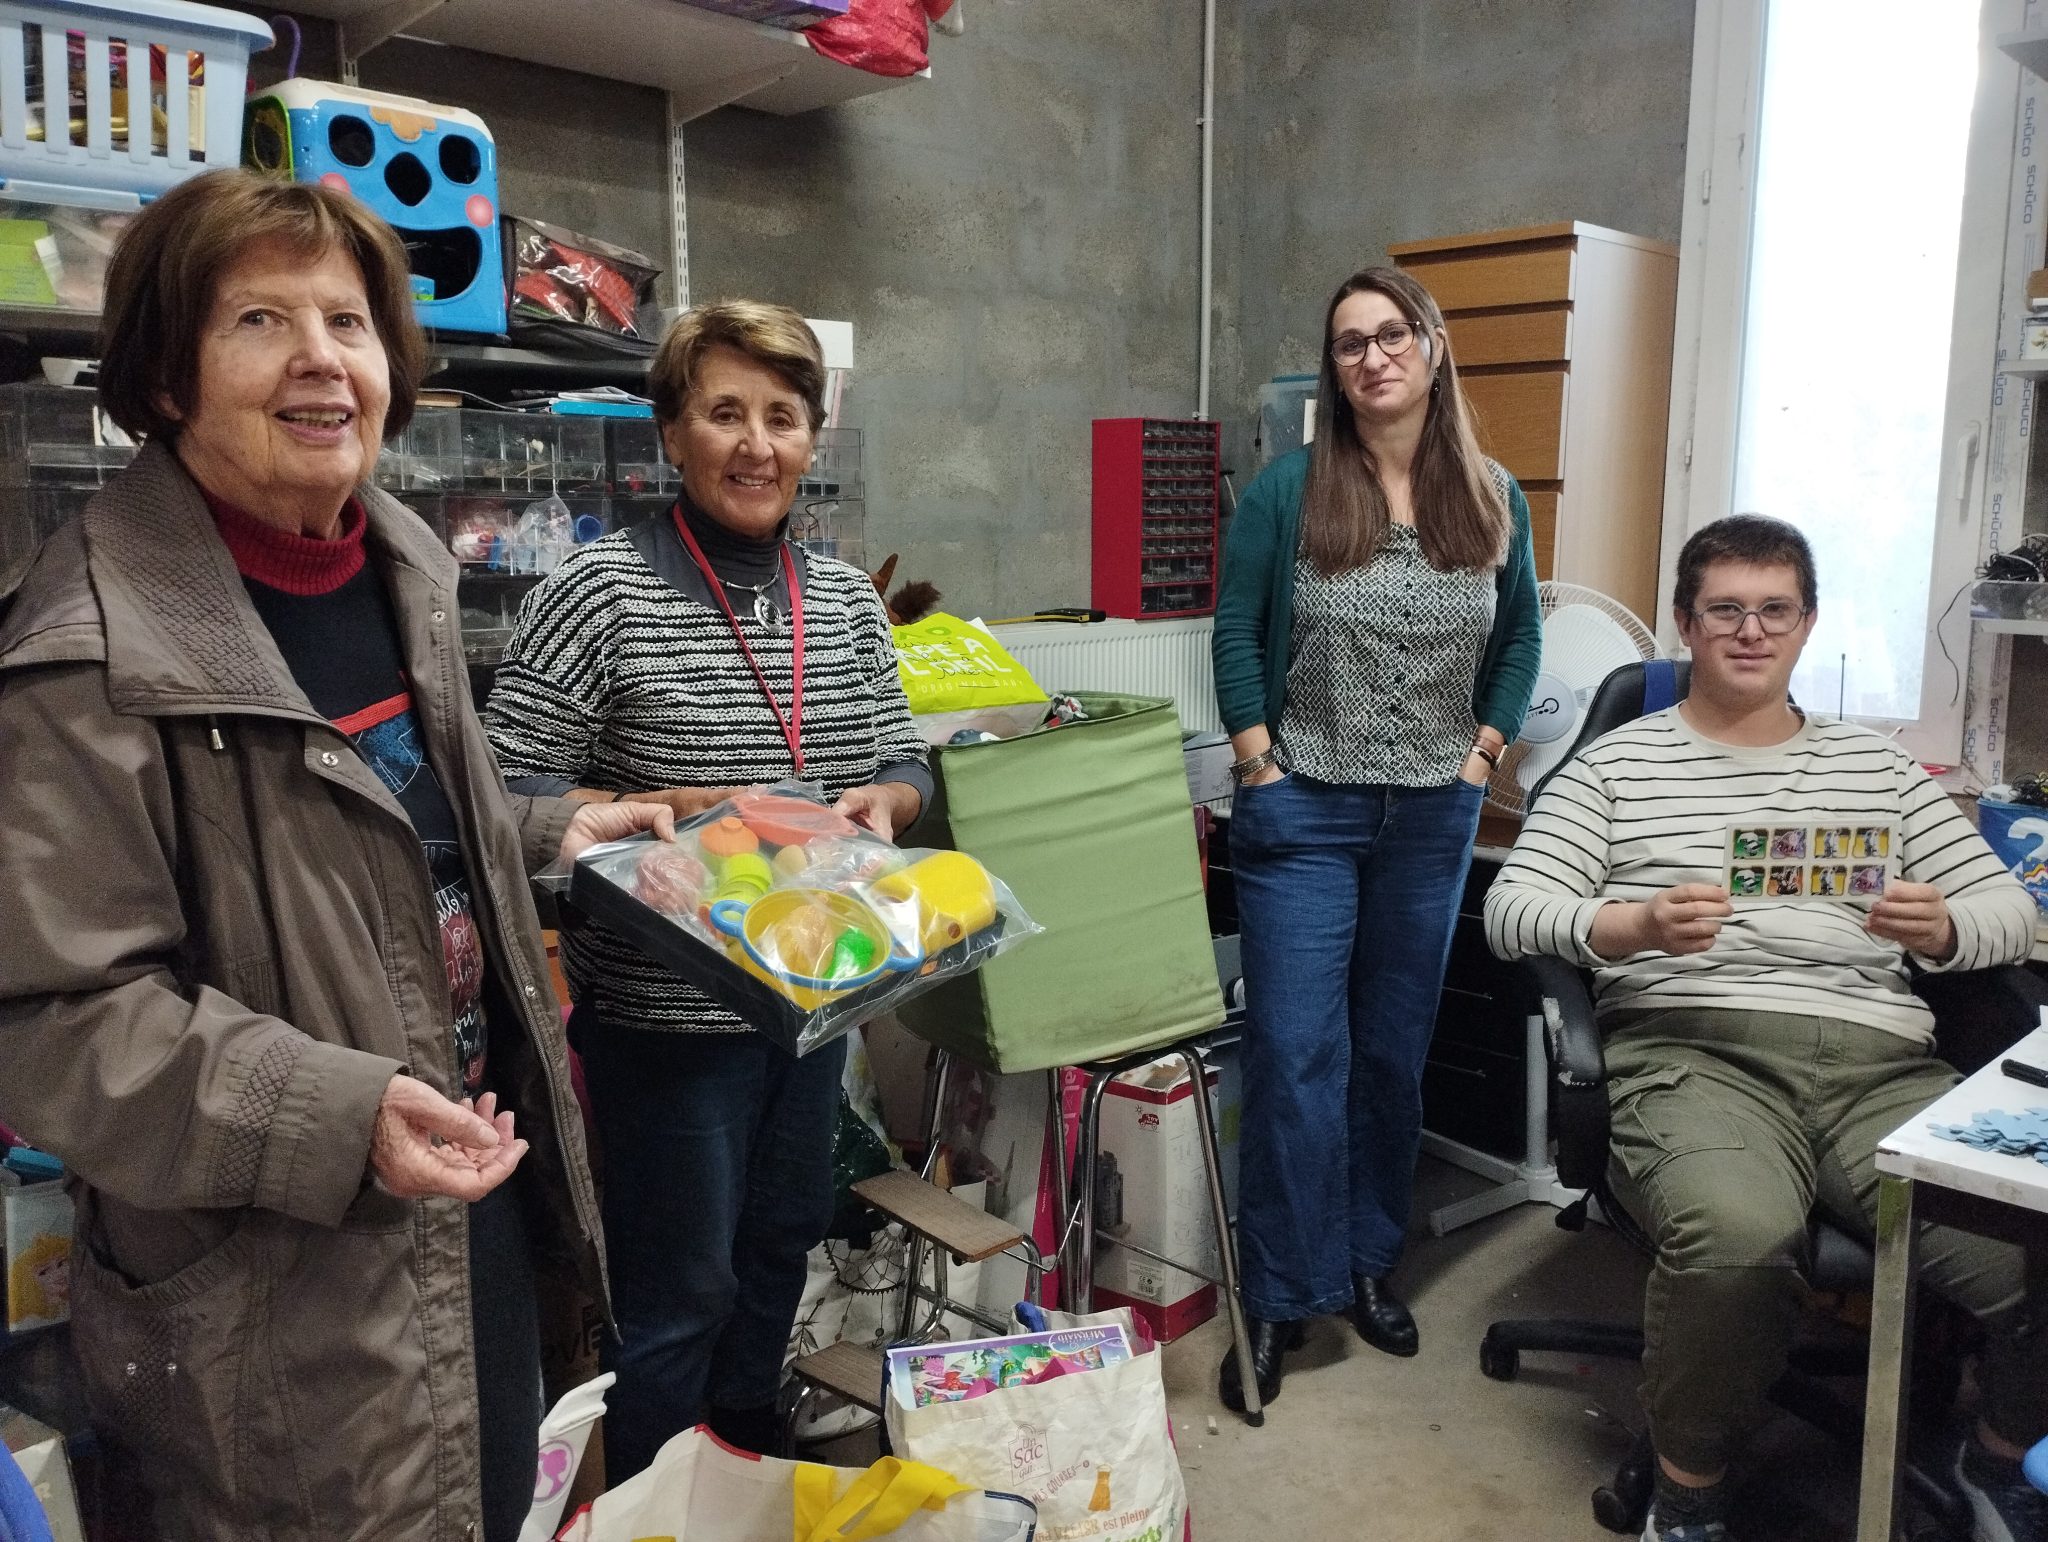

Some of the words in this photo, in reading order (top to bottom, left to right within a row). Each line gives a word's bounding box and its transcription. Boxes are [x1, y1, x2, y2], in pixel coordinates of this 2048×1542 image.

[2022, 97, 2036, 157] SCHÜCO
[2023, 164, 2037, 224] SCHÜCO
[1990, 494, 2002, 549] SCHÜCO
[921, 681, 987, 694] ORIGINAL
[1987, 698, 2001, 752] SCHÜCO
[1992, 760, 2001, 786] SCH
[1057, 1329, 1106, 1343] MERMAID
[1014, 1444, 1044, 1469] Sac
[1047, 1465, 1077, 1494] COURSES
[1103, 1517, 1118, 1531] est
